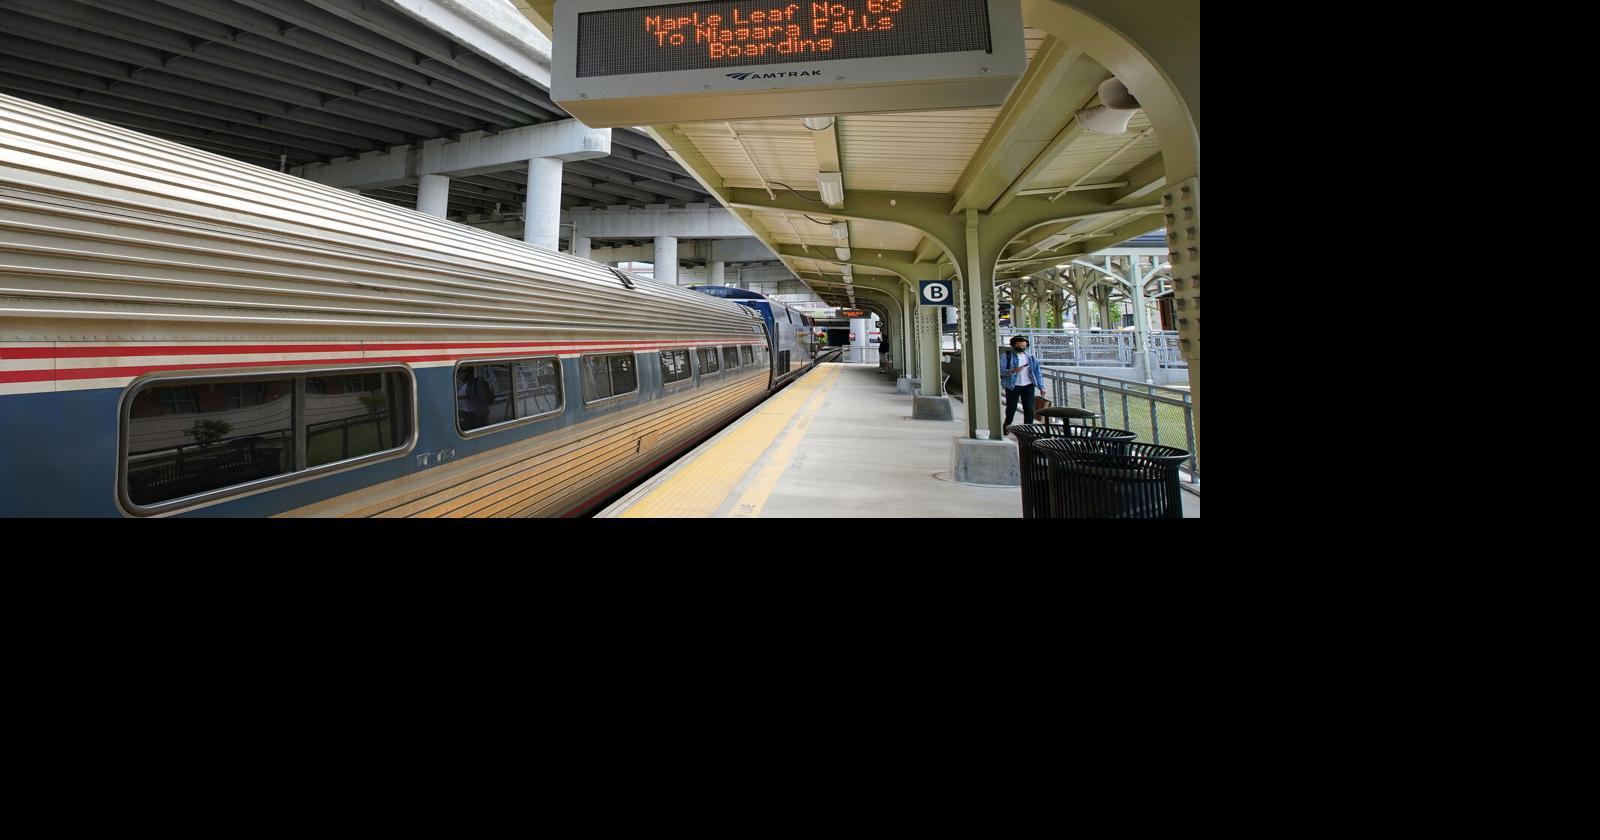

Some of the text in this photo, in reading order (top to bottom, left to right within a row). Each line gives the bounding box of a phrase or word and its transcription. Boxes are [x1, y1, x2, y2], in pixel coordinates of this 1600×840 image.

[645, 11, 722, 33] Maple
[733, 4, 799, 24] Leaf
[811, 1, 855, 17] No.
[654, 14, 894, 46] To Niagara Falls
[709, 37, 833, 58] Boarding
[751, 70, 822, 79] AMTRAK
[930, 285, 943, 299] B
